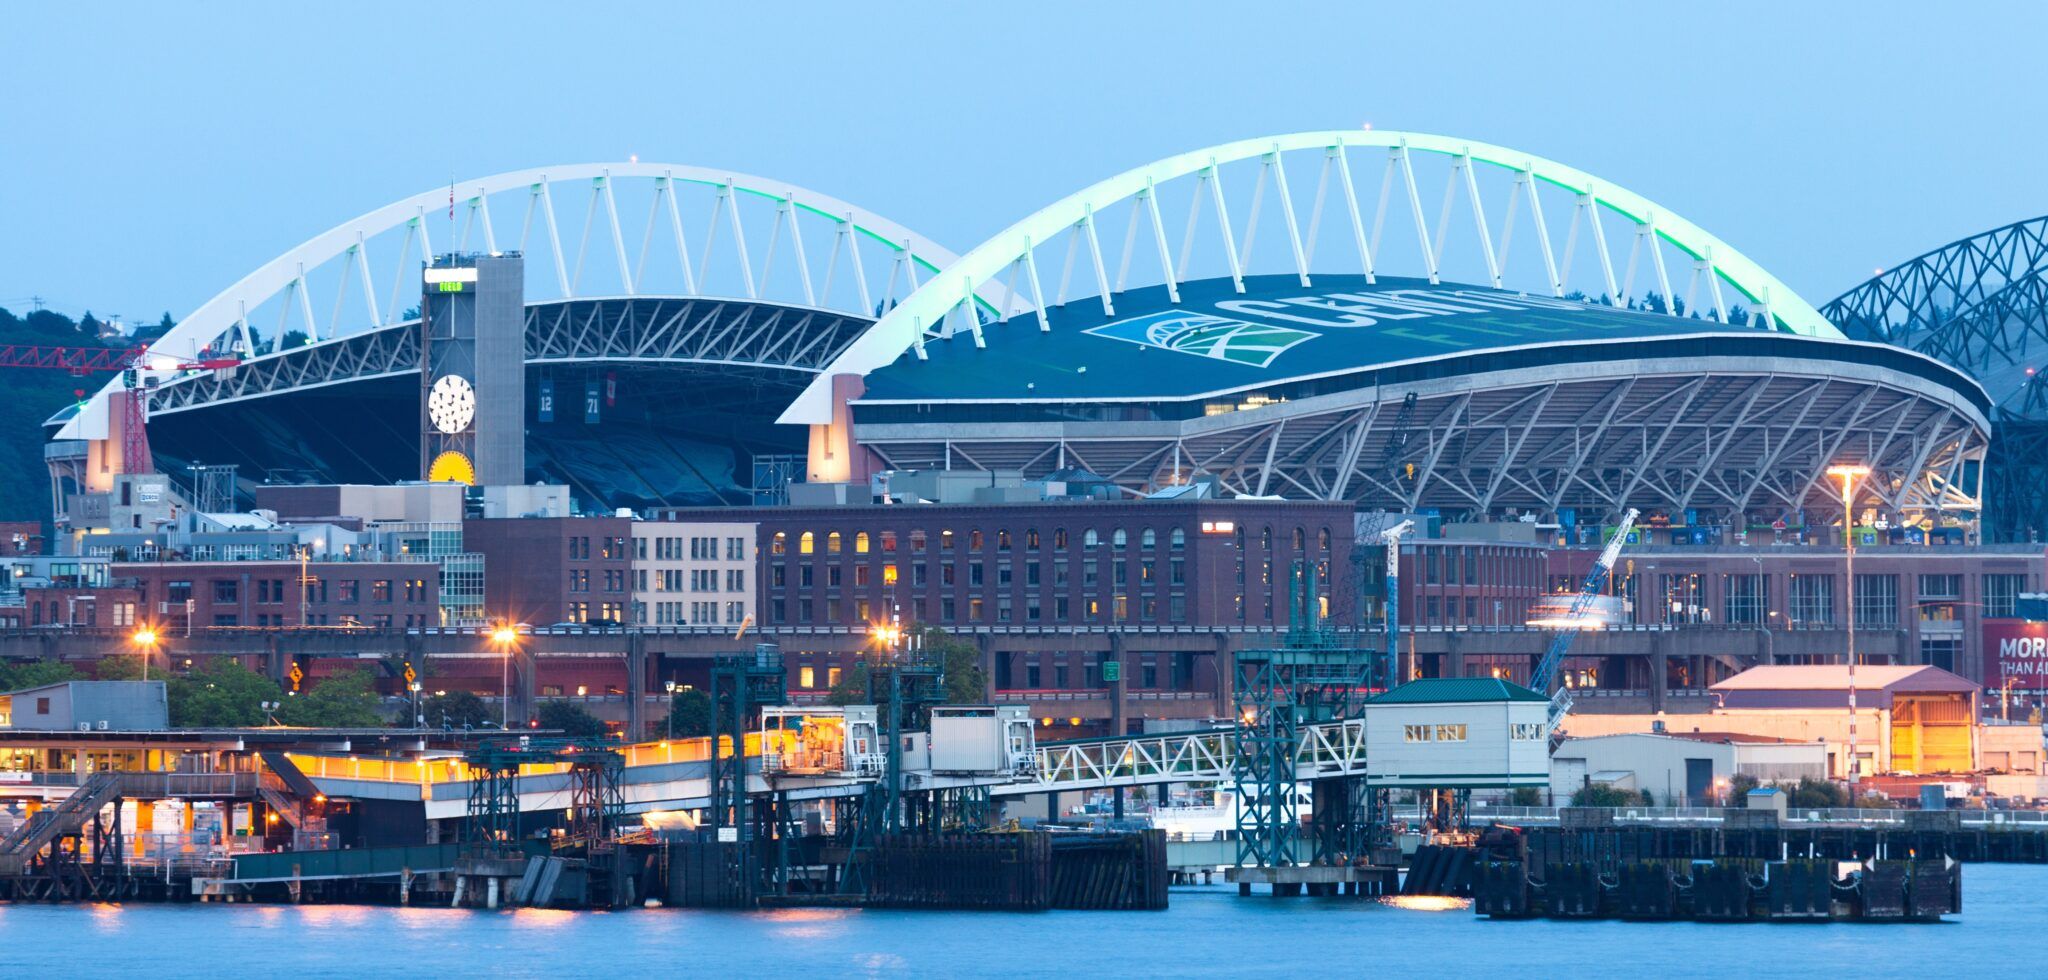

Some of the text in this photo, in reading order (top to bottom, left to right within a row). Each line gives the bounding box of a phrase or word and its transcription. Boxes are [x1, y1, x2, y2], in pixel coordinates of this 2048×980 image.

[541, 396, 552, 412] 12
[587, 398, 598, 414] 71
[1999, 637, 2048, 658] MOR
[1999, 661, 2033, 675] THAN
